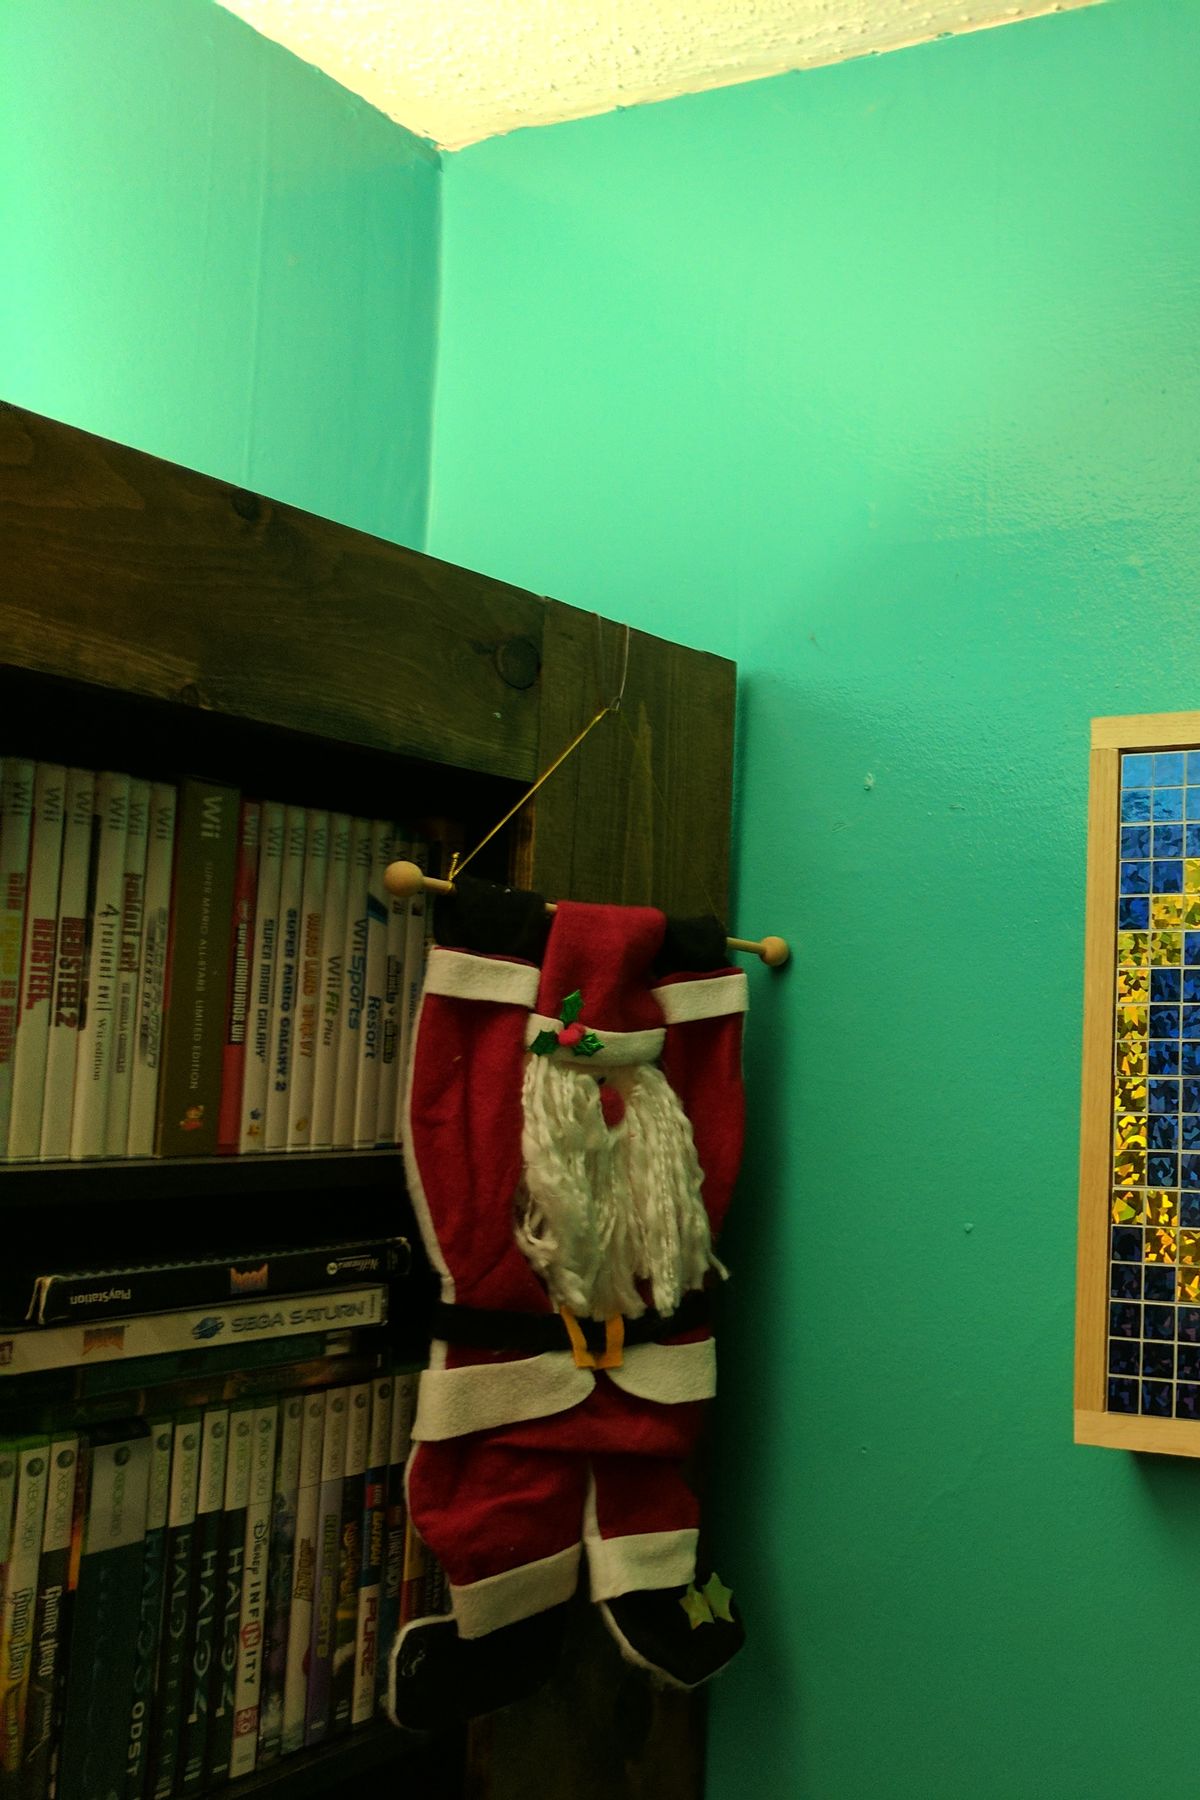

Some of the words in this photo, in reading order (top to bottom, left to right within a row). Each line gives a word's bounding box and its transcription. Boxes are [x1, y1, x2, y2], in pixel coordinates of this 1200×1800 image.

[11, 781, 31, 817] Wii
[43, 788, 62, 823] Wii
[73, 792, 93, 827] Wii
[108, 797, 128, 831] Wii
[128, 802, 146, 836] Wii
[155, 807, 174, 841] Wii
[200, 795, 225, 840] Wii
[241, 815, 258, 846] Wii
[266, 826, 285, 858] Wii
[288, 827, 306, 857] Wii
[310, 828, 327, 859] Wii
[334, 831, 350, 862] Wii
[355, 837, 373, 868] Wii
[378, 836, 395, 866] Wii
[200, 896, 212, 936] MARIO
[284, 908, 298, 958] SUPER
[262, 919, 276, 960] SUPER
[353, 917, 369, 953] Wii
[259, 963, 274, 1006] MARIO
[281, 964, 297, 1012] MARIO
[326, 955, 343, 991] Wii
[325, 990, 341, 1015] Fit
[347, 954, 368, 1031] Sports
[54, 1010, 79, 1029] 2
[192, 998, 206, 1041] LIMITED
[256, 1009, 271, 1058] GALAXY
[322, 1017, 336, 1047] Plus
[365, 995, 384, 1060] Resort
[277, 1017, 292, 1077] GALAXY
[188, 1045, 202, 1089] EDITION
[275, 1079, 288, 1092] 2
[70, 1287, 132, 1305] PlayStation
[231, 1311, 286, 1333] SEGA
[290, 1299, 365, 1326] SATURN
[169, 1534, 192, 1639] HALO
[194, 1550, 219, 1679] HALO
[221, 1547, 245, 1672] HALO
[239, 1580, 263, 1687] INFINITY
[361, 1597, 378, 1677] PURE
[160, 1654, 181, 1769] REACH
[125, 1700, 146, 1778] ODST
